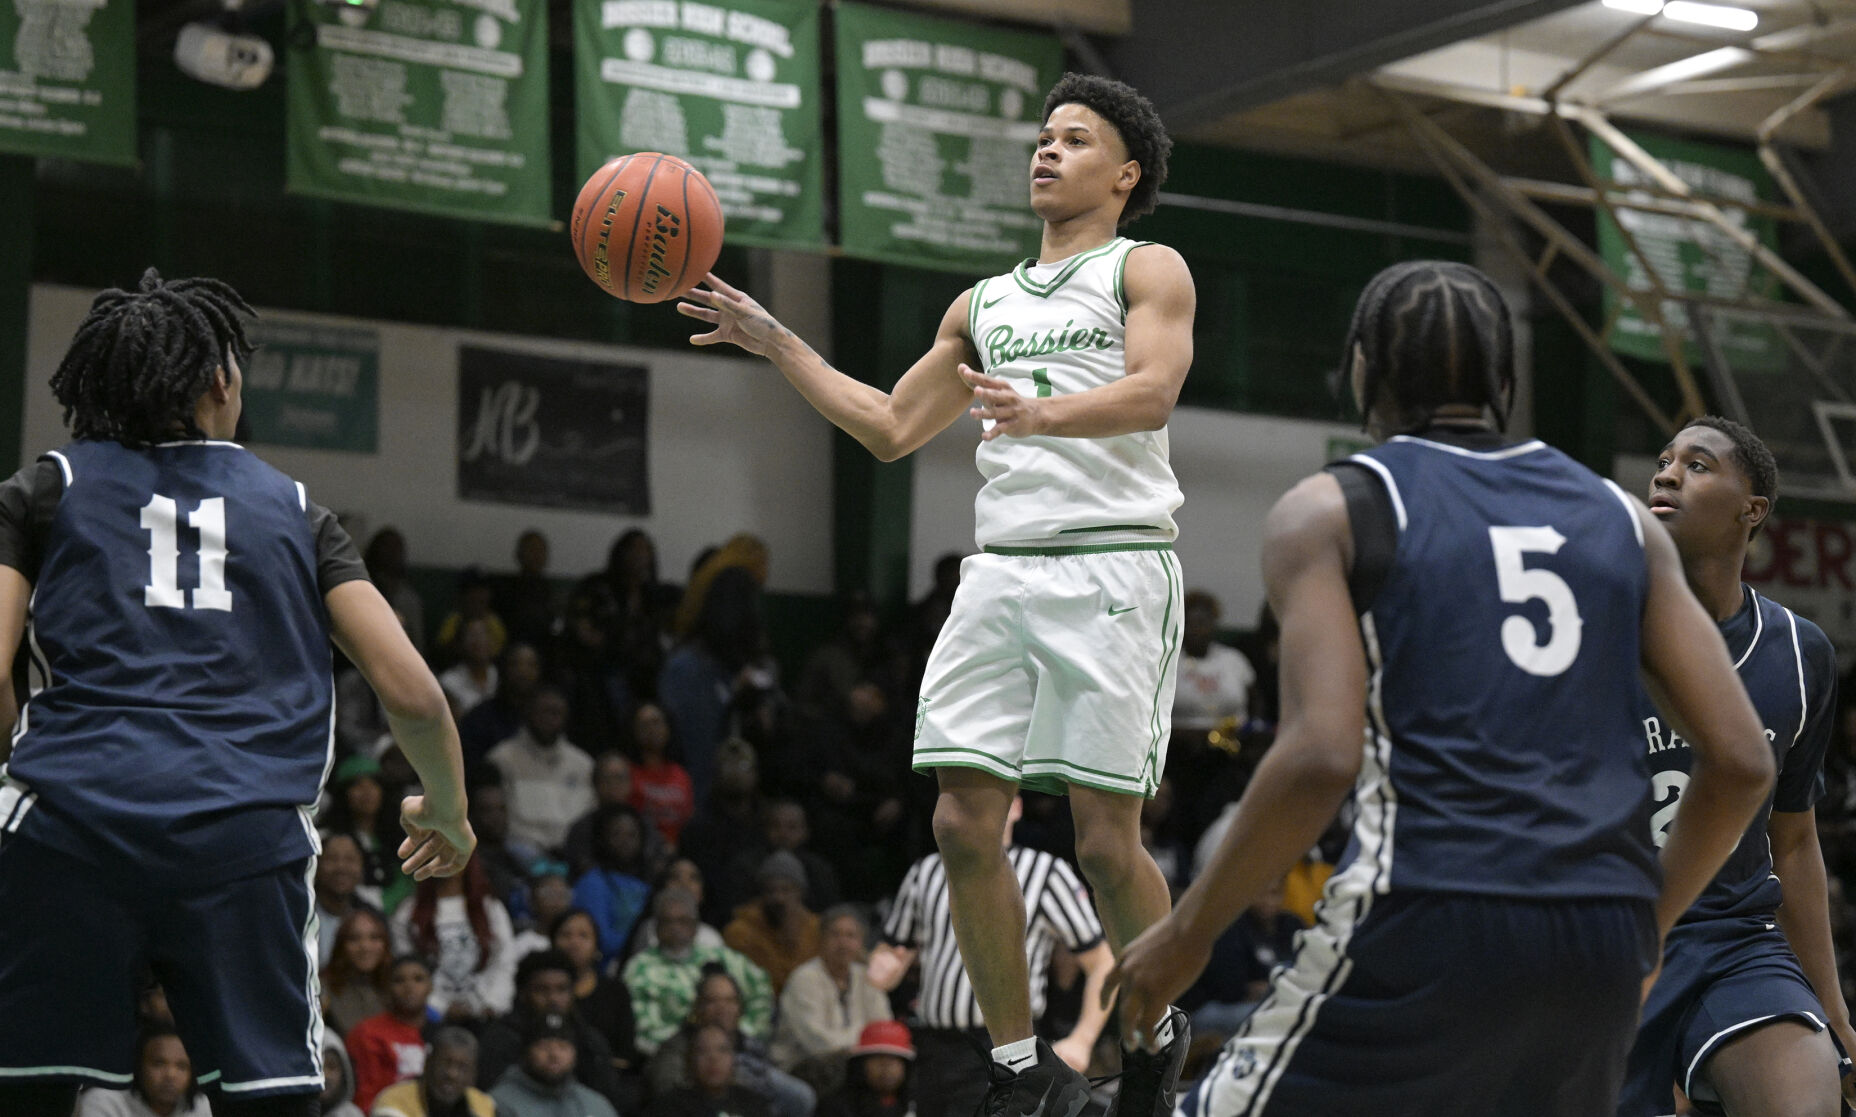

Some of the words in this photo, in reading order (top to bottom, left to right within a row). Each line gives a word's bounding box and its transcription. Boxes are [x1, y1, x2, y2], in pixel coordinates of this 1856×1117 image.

[641, 203, 680, 294] Baden
[985, 319, 1115, 374] Bossier
[139, 493, 233, 613] 11
[1488, 525, 1584, 677] 5
